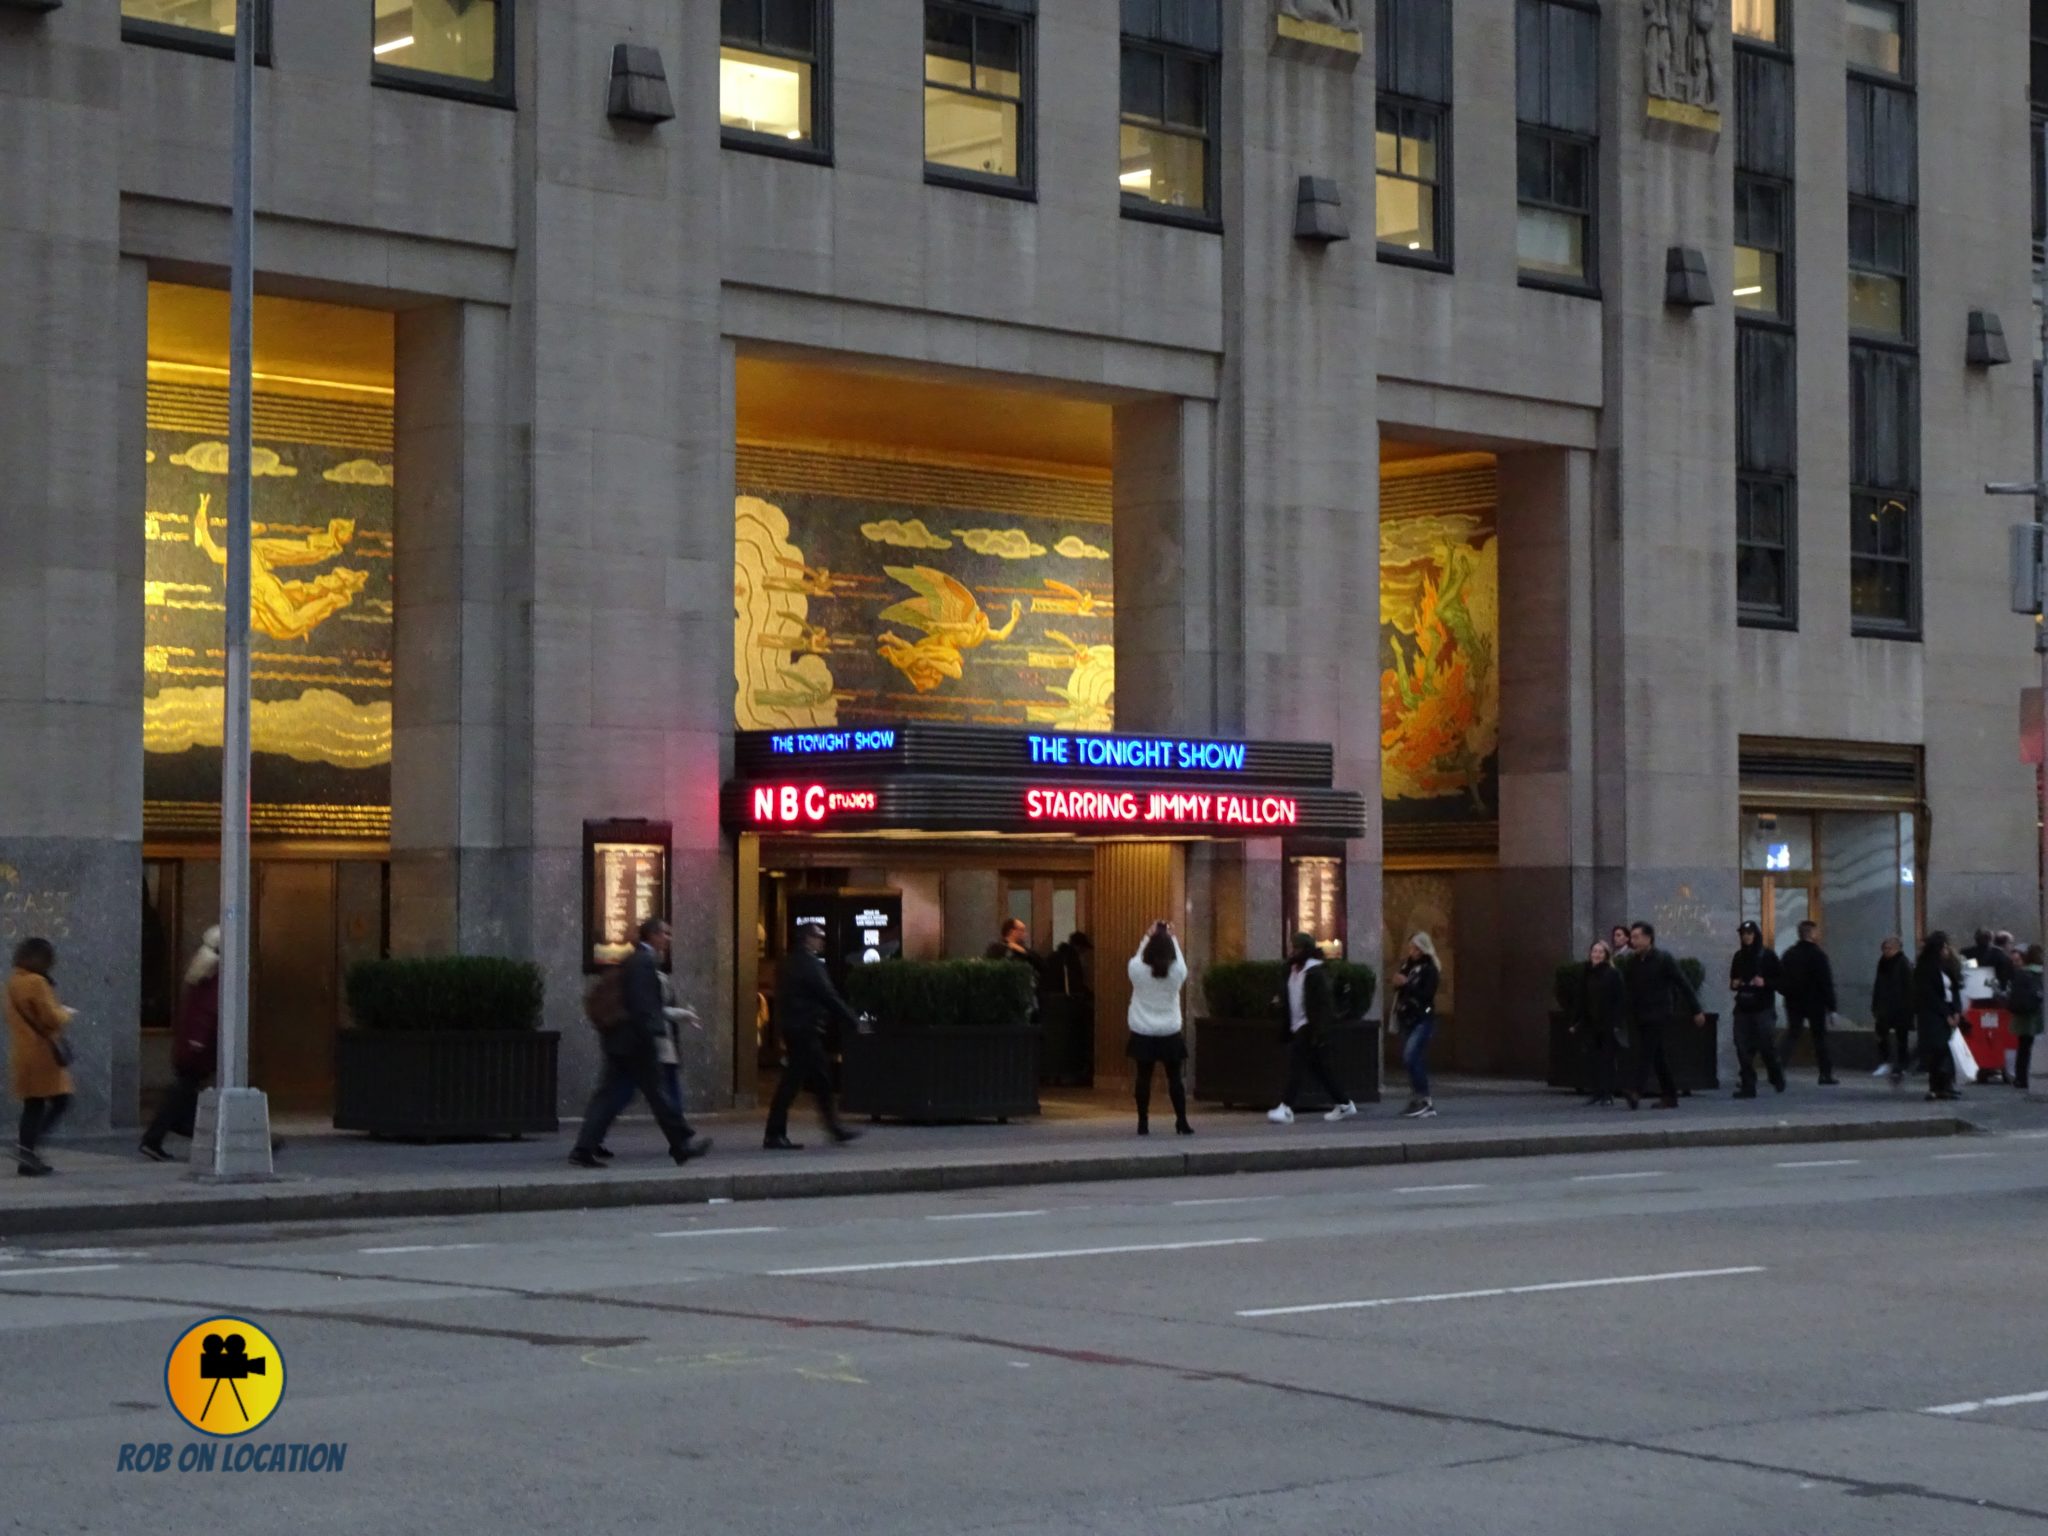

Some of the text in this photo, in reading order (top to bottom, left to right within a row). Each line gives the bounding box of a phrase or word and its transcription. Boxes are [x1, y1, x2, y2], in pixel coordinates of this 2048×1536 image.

[772, 730, 895, 752] THE TONIGHT SHOW
[1028, 735, 1246, 770] THE TONIGHT SHOW
[754, 784, 826, 822] NBC
[1026, 789, 1296, 824] STARRING JIMMY FALLON
